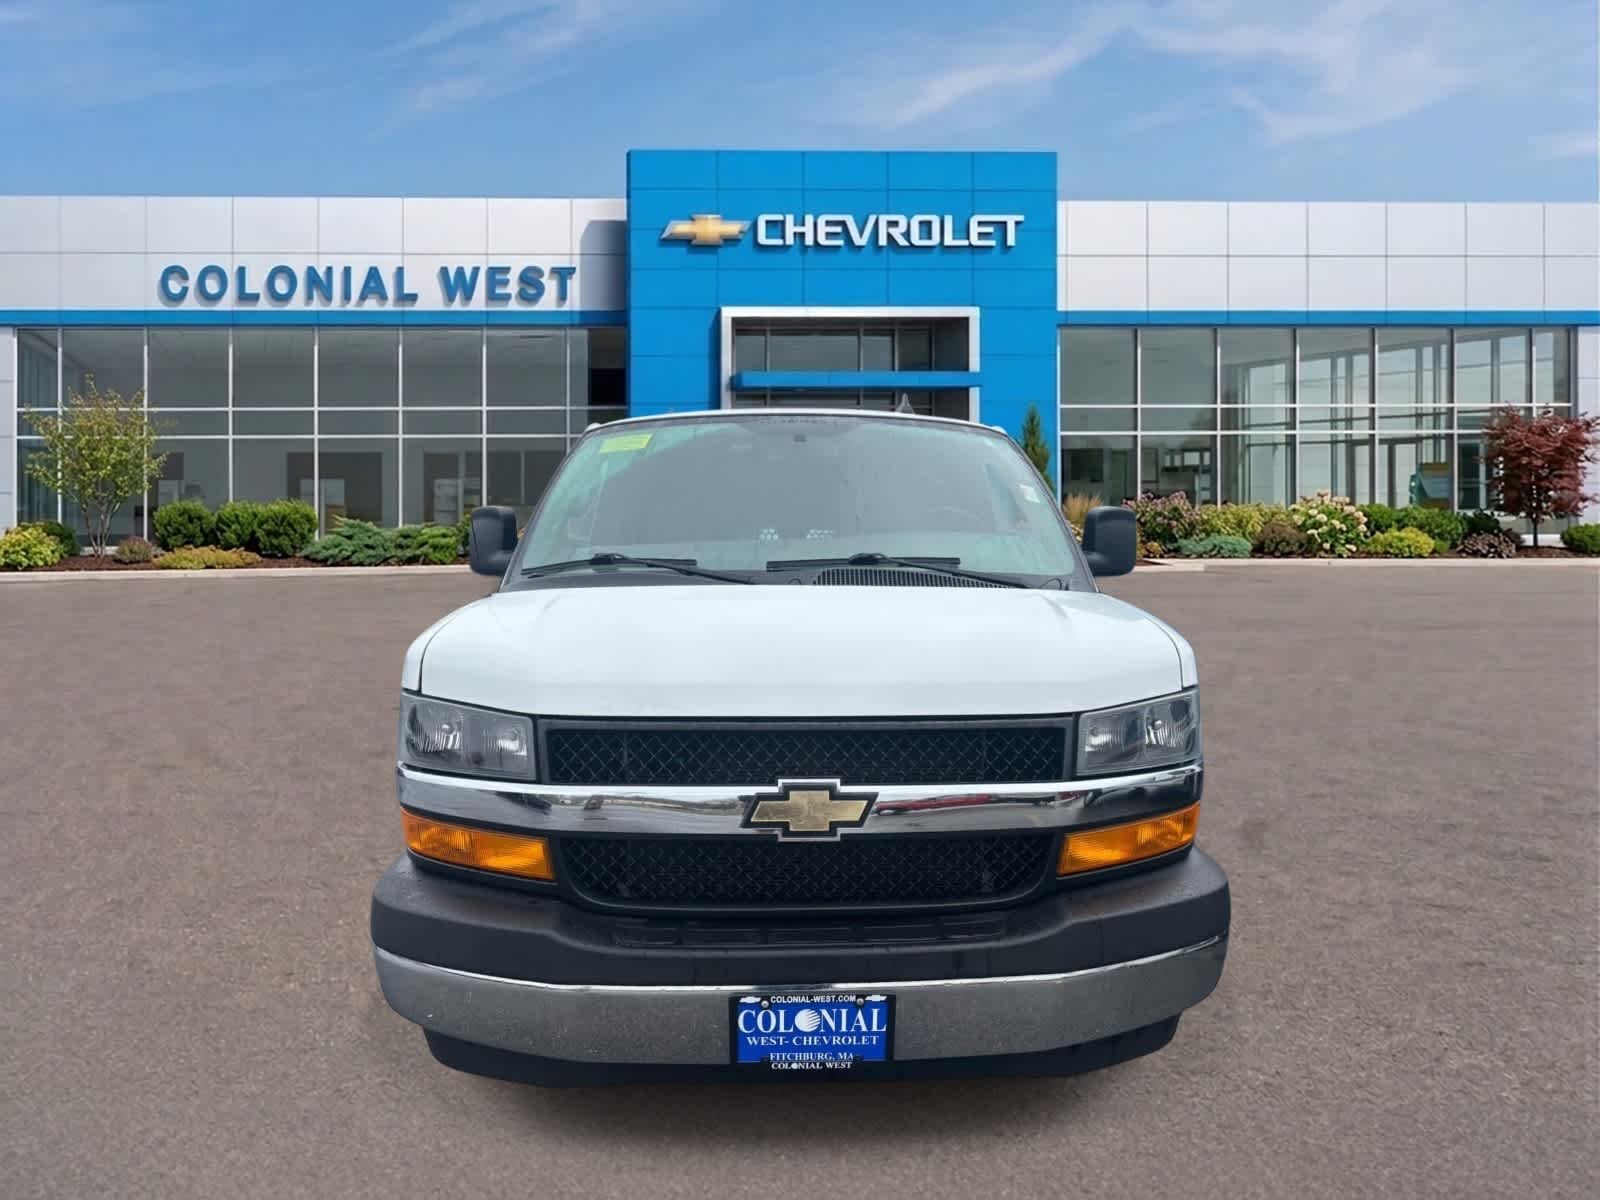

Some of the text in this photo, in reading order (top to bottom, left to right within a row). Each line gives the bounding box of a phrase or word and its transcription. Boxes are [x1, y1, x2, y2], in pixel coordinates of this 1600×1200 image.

[756, 213, 1025, 247] CHEVROLET
[158, 265, 576, 303] COLONIAL WEST
[770, 995, 857, 1004] COLONIAL-WEST.COM
[738, 1008, 887, 1033] COLONIAL
[838, 1052, 854, 1061] MA
[771, 1062, 823, 1070] COLONIAL
